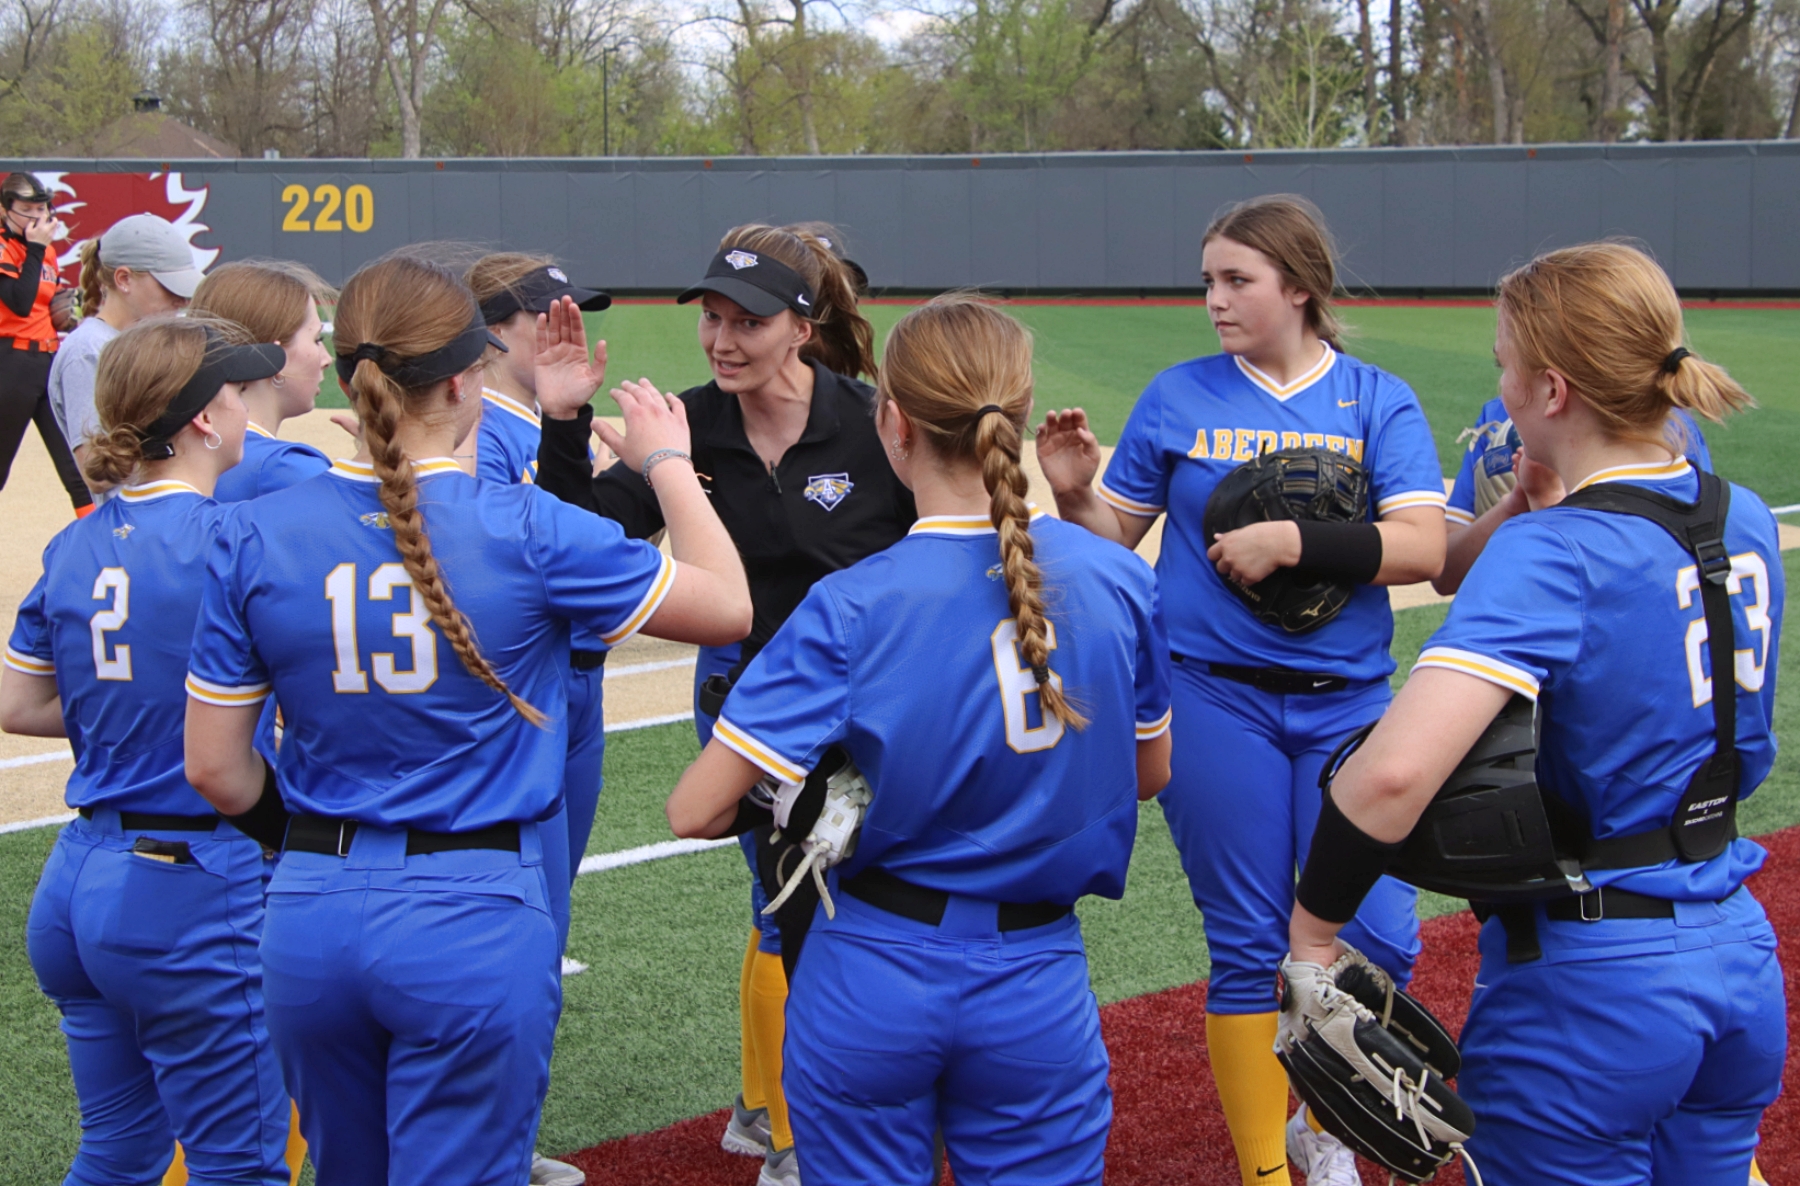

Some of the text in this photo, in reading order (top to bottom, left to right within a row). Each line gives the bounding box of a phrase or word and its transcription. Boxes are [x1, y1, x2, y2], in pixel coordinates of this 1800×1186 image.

[281, 183, 375, 233] 220
[89, 566, 133, 681] 2
[324, 562, 439, 694] 13
[990, 616, 1065, 754] 6
[1675, 551, 1772, 709] 23
[1687, 795, 1729, 812] EASTON
